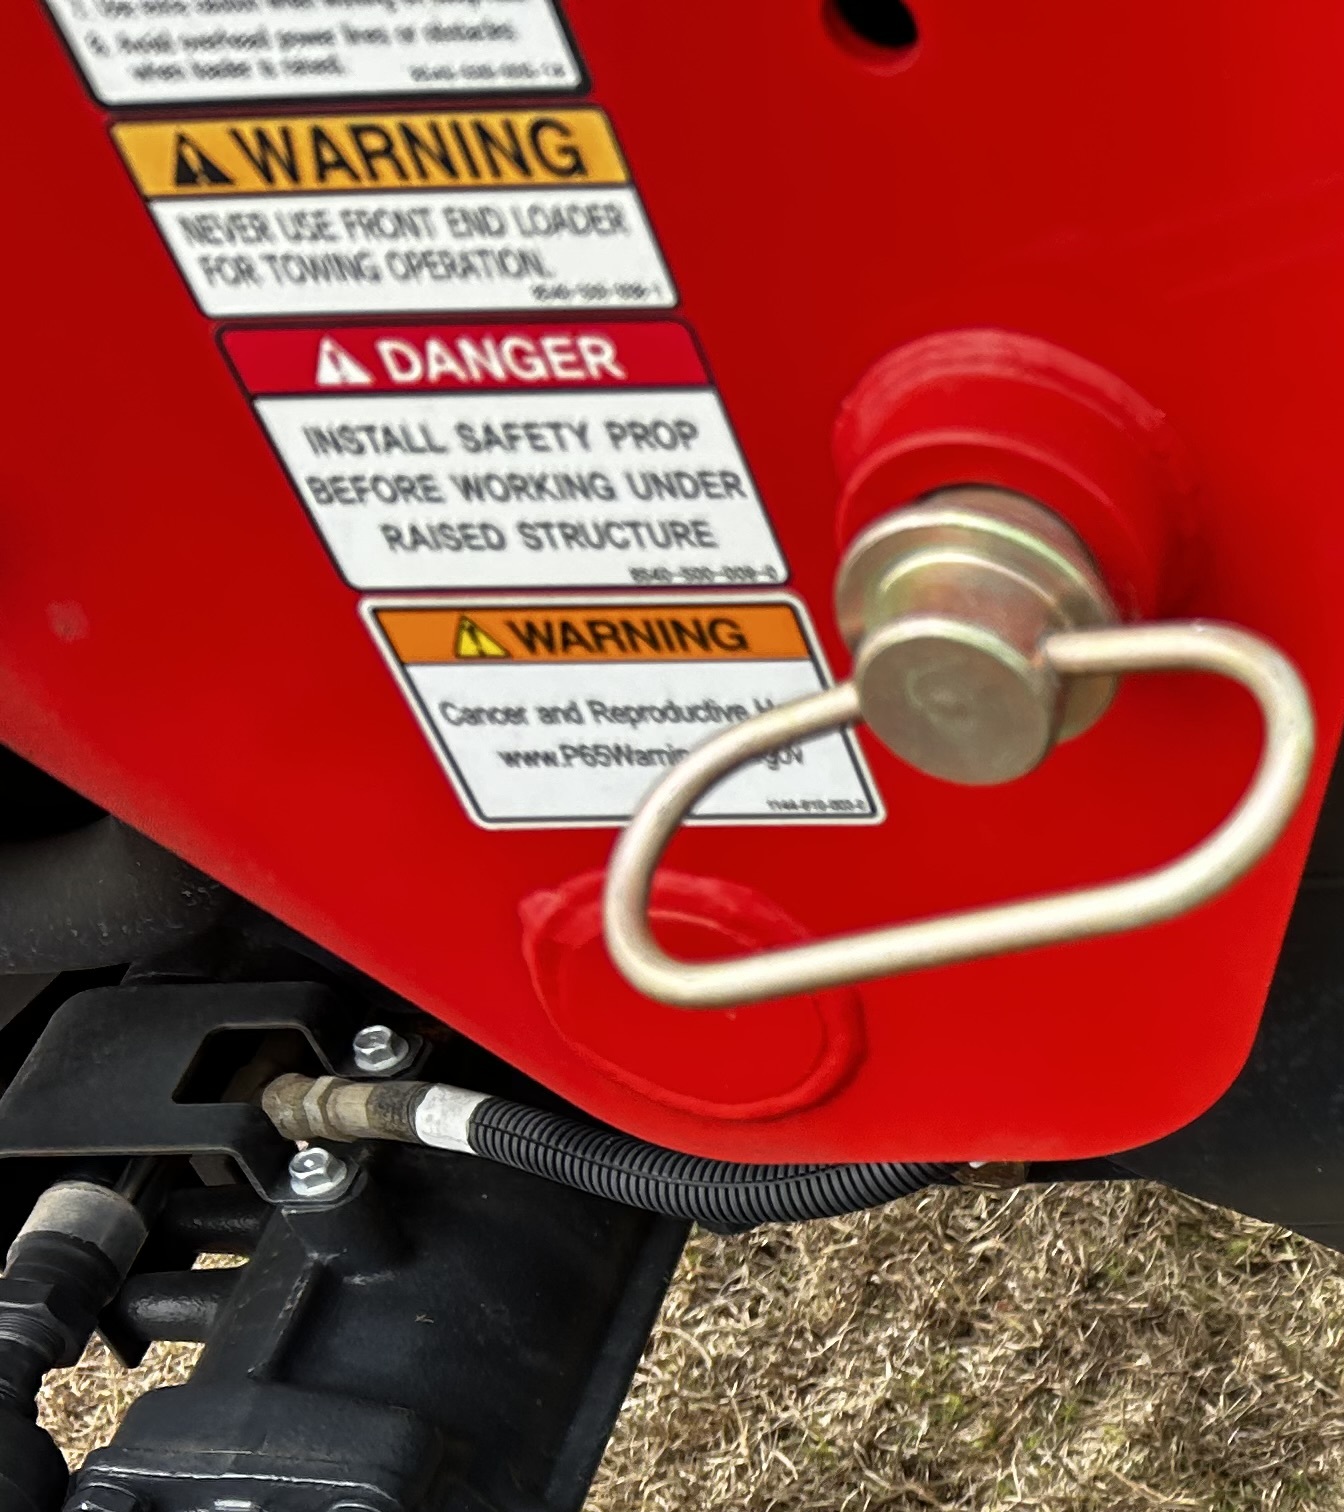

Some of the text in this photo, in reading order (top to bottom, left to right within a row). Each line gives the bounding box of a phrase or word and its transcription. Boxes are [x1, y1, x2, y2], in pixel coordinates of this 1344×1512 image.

[229, 116, 588, 186] WARNING
[176, 202, 630, 247] NEVER USE FRONT END LOADER
[197, 247, 556, 287] FOR TOWING OPERATION.
[374, 335, 629, 384] DANGER
[301, 418, 700, 457] INSTALL SAFETY PROP
[303, 469, 749, 505] BEFORE WORKING UNDER
[379, 518, 720, 553] RAISED STRUCTURE
[506, 616, 752, 659] WARNING
[439, 700, 529, 728] Cancer
[538, 701, 585, 726] and
[589, 698, 748, 731] Reproductive
